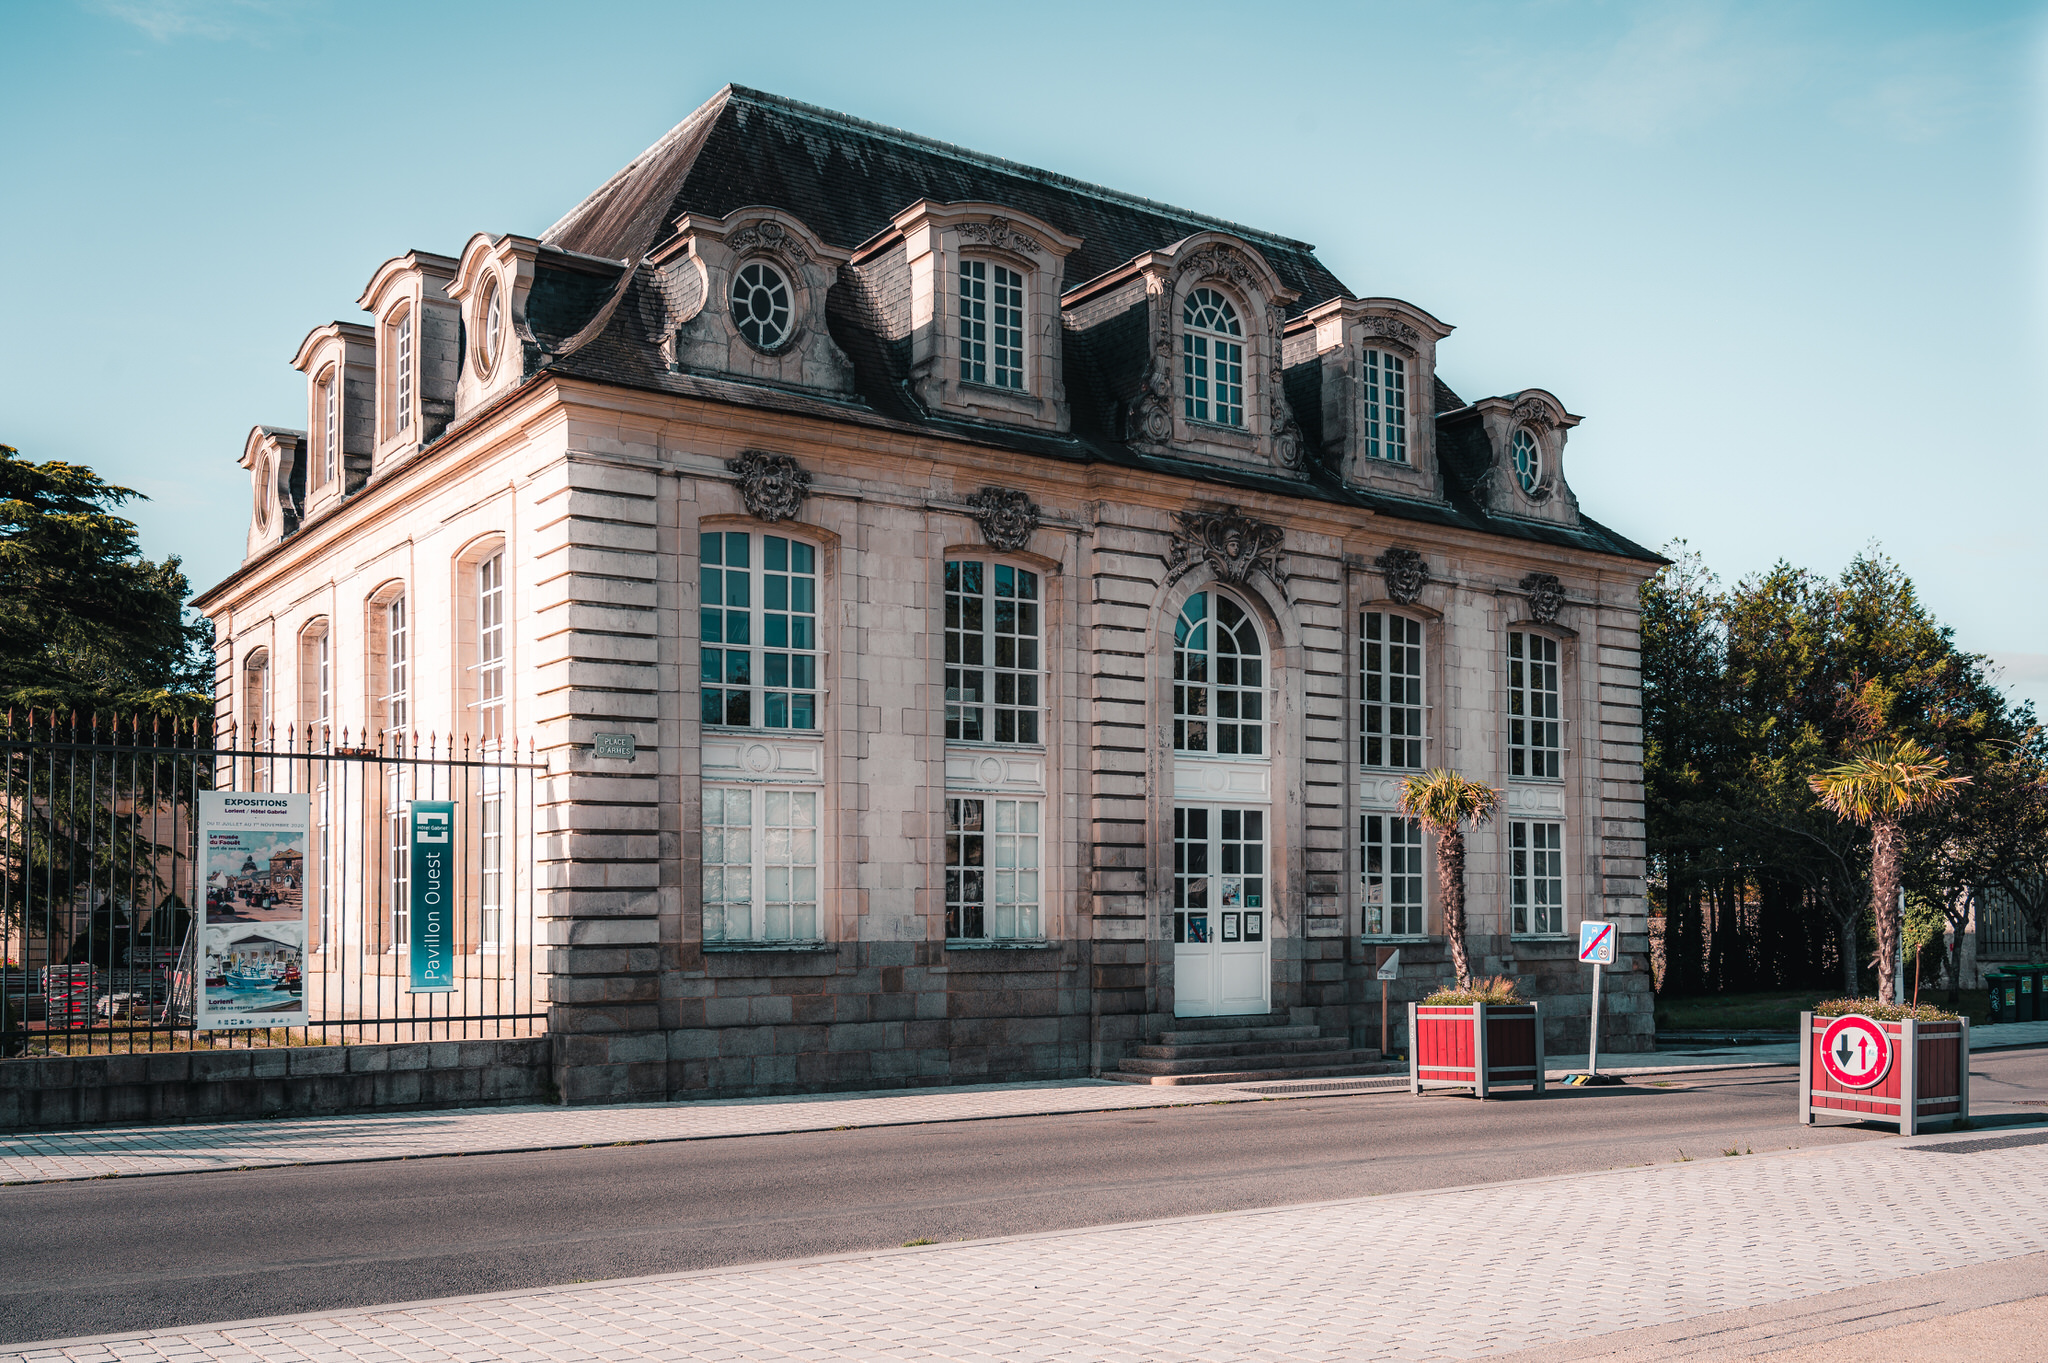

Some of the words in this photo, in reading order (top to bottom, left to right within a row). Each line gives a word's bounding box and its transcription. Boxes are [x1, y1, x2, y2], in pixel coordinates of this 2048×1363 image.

[599, 745, 631, 755] D'ARMES
[224, 798, 288, 807] EXPOSITIONS
[424, 851, 441, 905] Ouest
[424, 911, 440, 979] Pavillon
